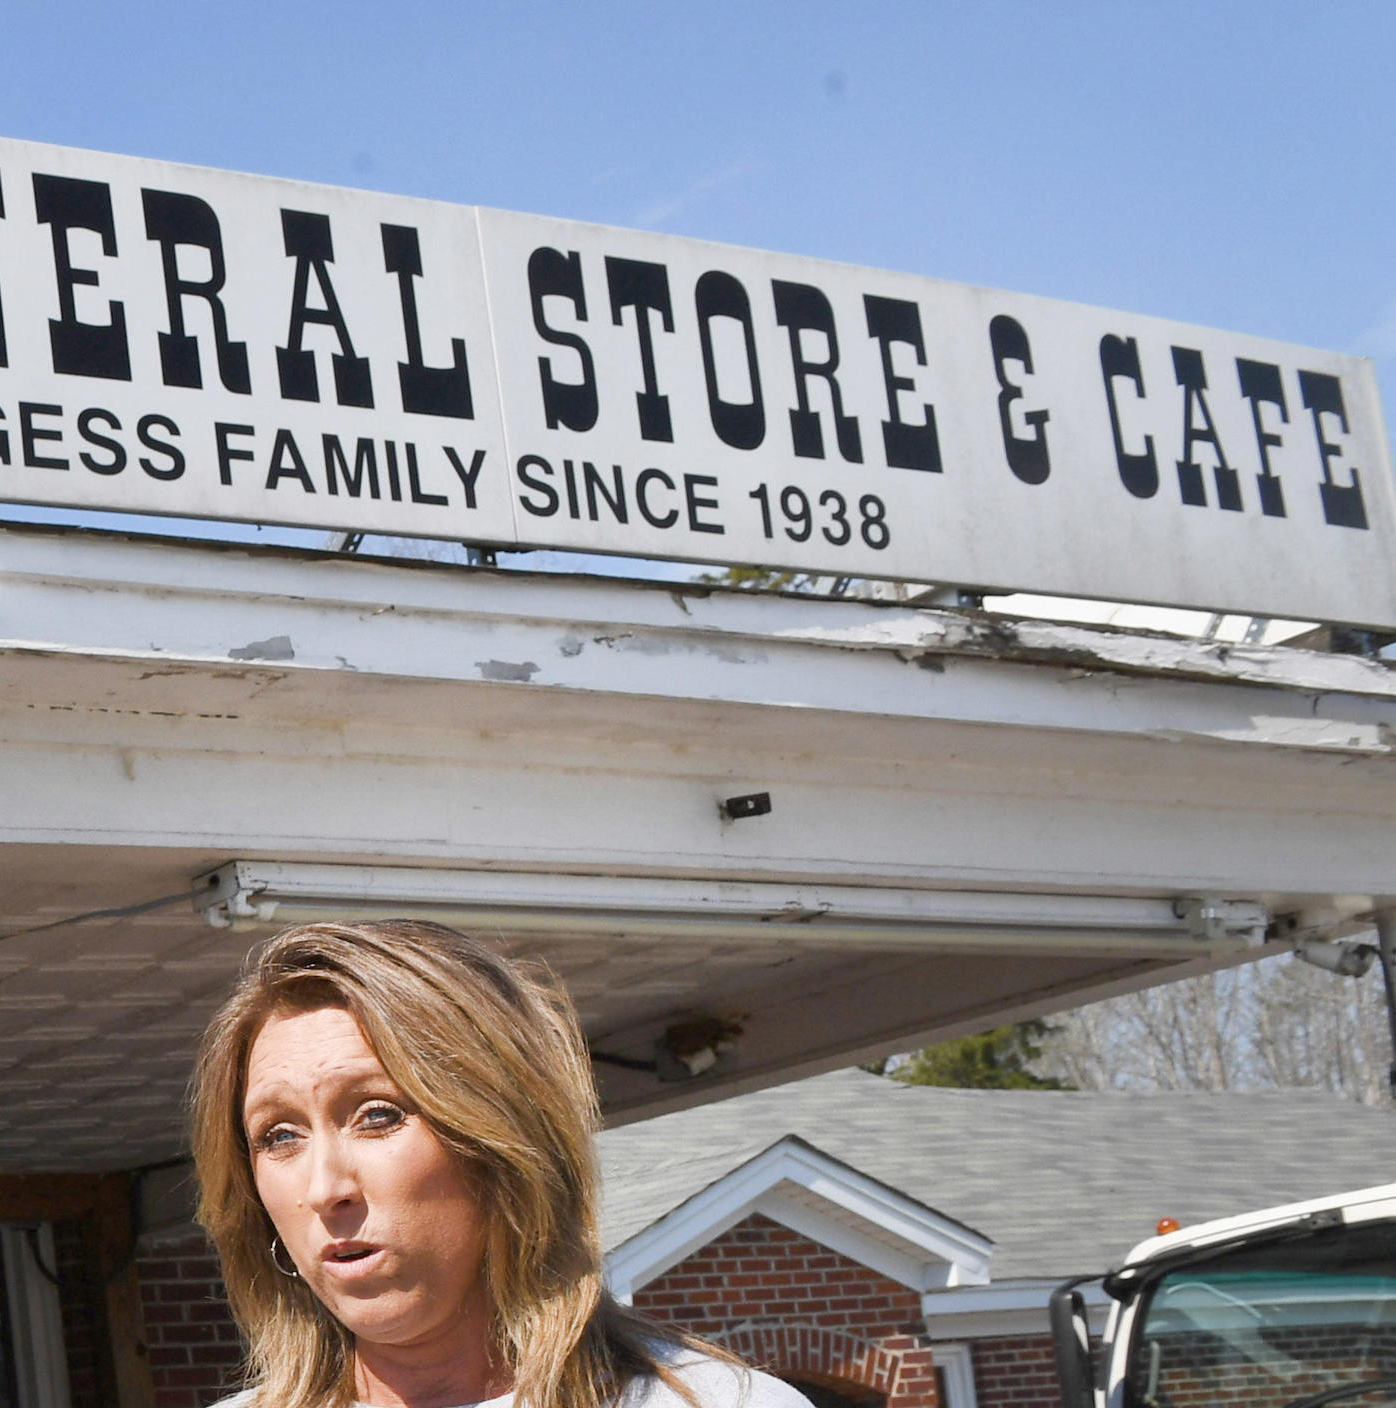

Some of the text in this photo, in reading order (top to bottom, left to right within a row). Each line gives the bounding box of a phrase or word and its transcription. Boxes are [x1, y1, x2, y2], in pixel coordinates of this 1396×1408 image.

[213, 421, 487, 510] FAMILY
[518, 453, 725, 536] SINCE
[749, 483, 892, 551] 1938
[527, 246, 943, 473] STORE
[989, 314, 1051, 485] &
[1099, 333, 1368, 530] CAFE
